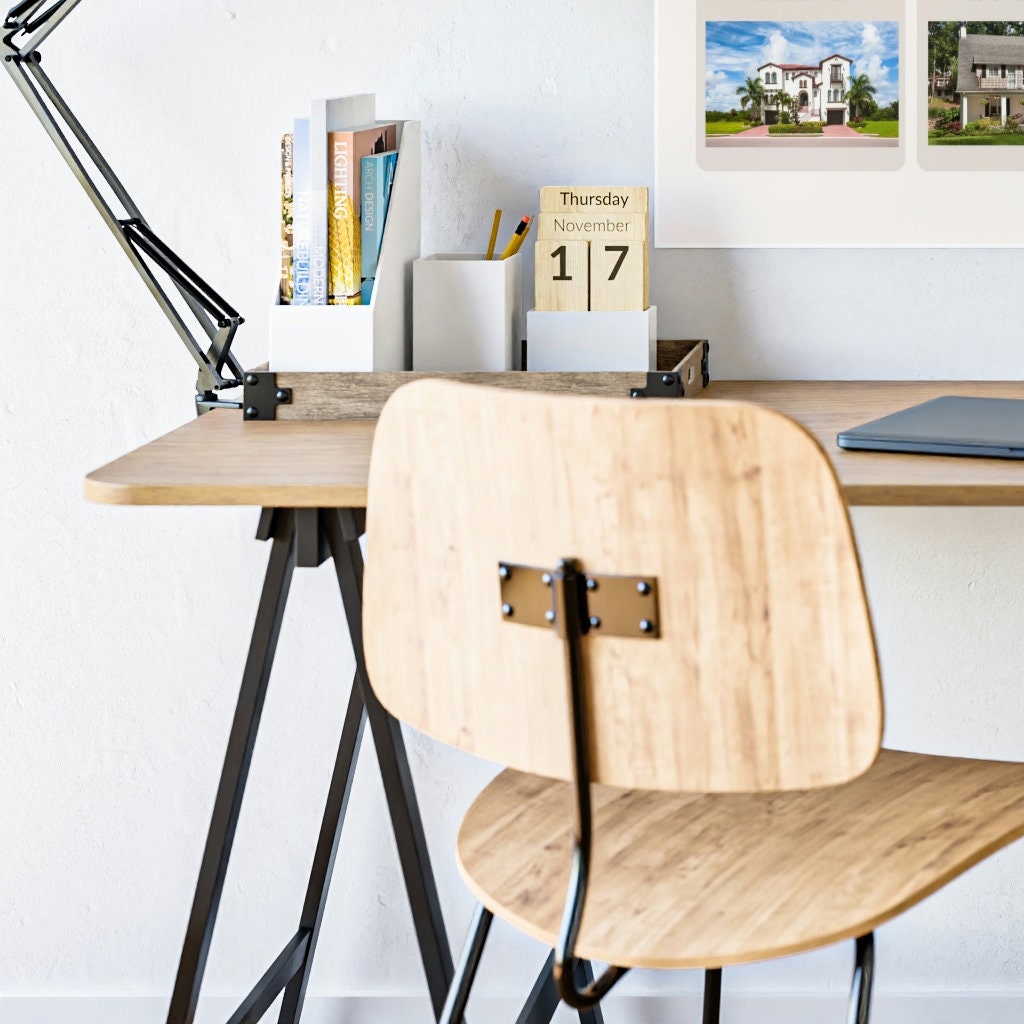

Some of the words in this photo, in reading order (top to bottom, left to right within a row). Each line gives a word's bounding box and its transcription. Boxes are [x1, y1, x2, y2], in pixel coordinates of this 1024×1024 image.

[333, 141, 348, 220] LIGHTING
[365, 161, 374, 190] ARCH
[364, 192, 374, 232] DESIGN
[559, 191, 630, 209] Thursday
[552, 217, 631, 233] November
[312, 245, 325, 305] MODERN
[550, 245, 573, 281] 1
[604, 245, 630, 281] 7
